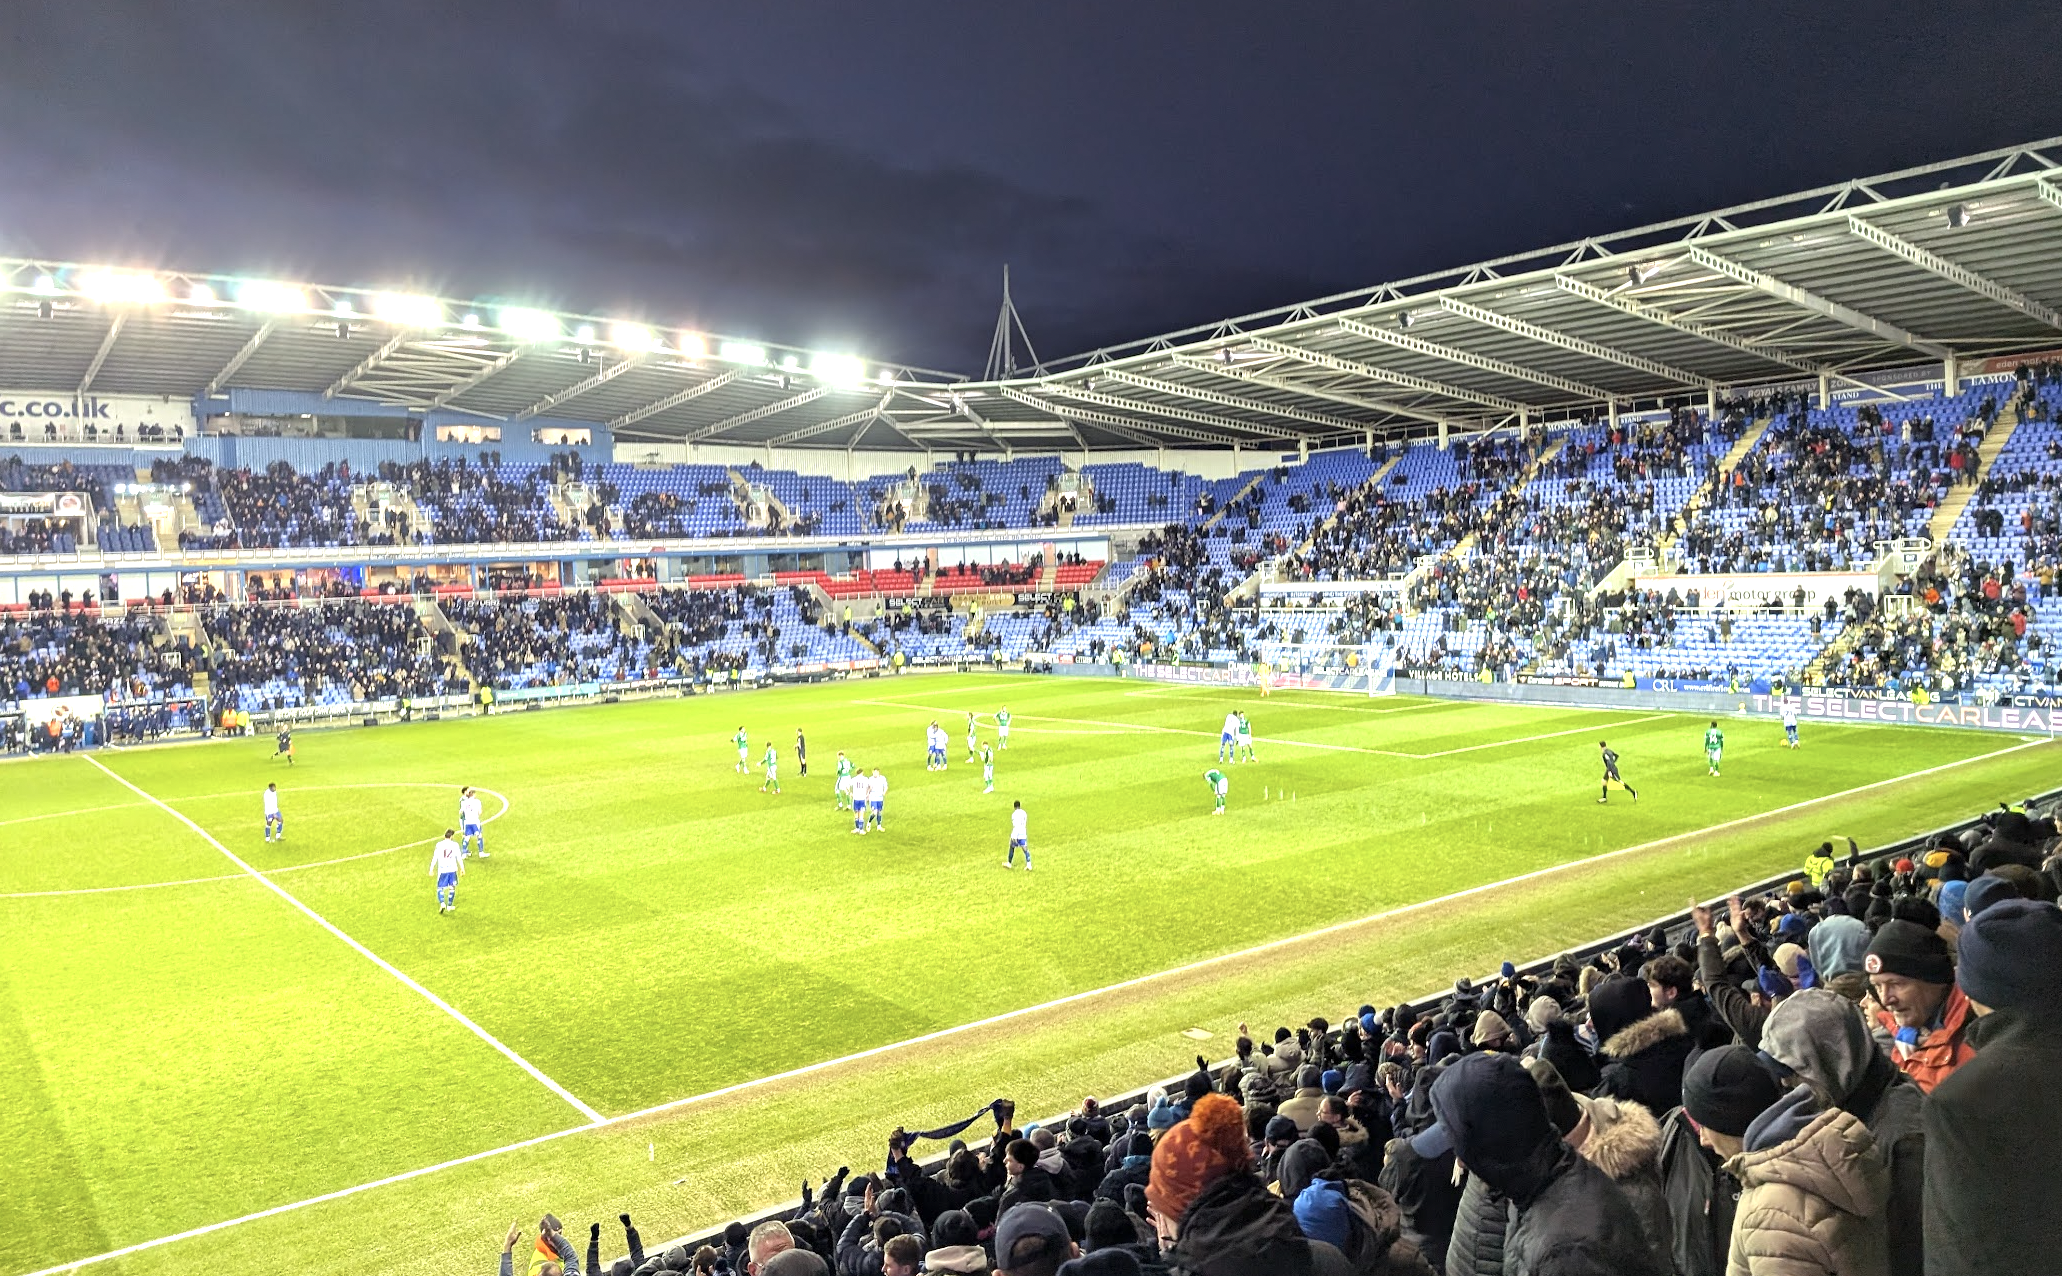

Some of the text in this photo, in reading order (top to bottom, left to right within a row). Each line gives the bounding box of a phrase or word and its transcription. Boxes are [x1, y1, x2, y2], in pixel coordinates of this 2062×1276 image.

[1971, 373, 2018, 387] EAMON
[1832, 381, 1944, 401] STAND THE
[889, 597, 923, 607] SELECT
[1018, 592, 1052, 602] SELECT
[1729, 589, 1772, 600] motor
[1774, 589, 1816, 603] grop
[1132, 663, 1155, 677] THE
[1408, 669, 1443, 681] VILLAGE
[1553, 676, 1598, 687] SPORT
[1653, 679, 1678, 693] CRL
